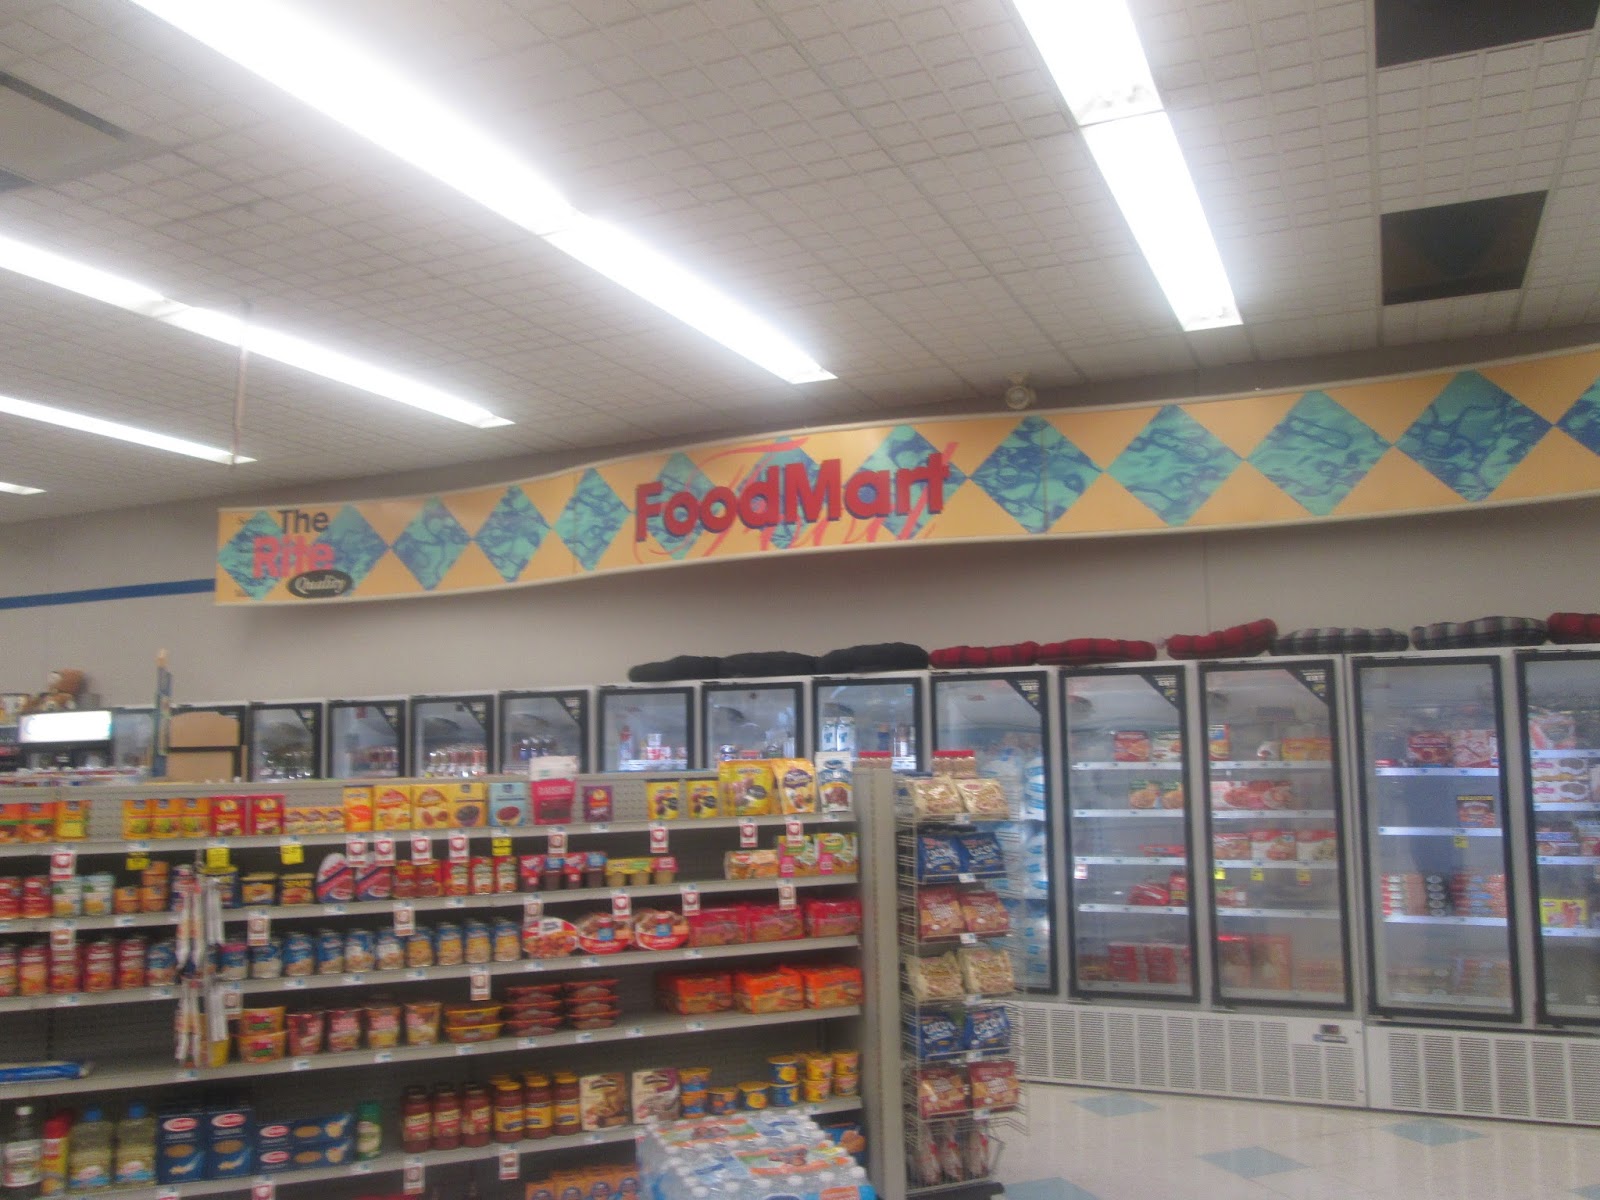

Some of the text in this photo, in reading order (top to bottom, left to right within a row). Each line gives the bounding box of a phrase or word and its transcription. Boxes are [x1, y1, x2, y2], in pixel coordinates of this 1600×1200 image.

[635, 452, 949, 542] FoodMart
[278, 509, 329, 534] The
[252, 534, 334, 579] Rite
